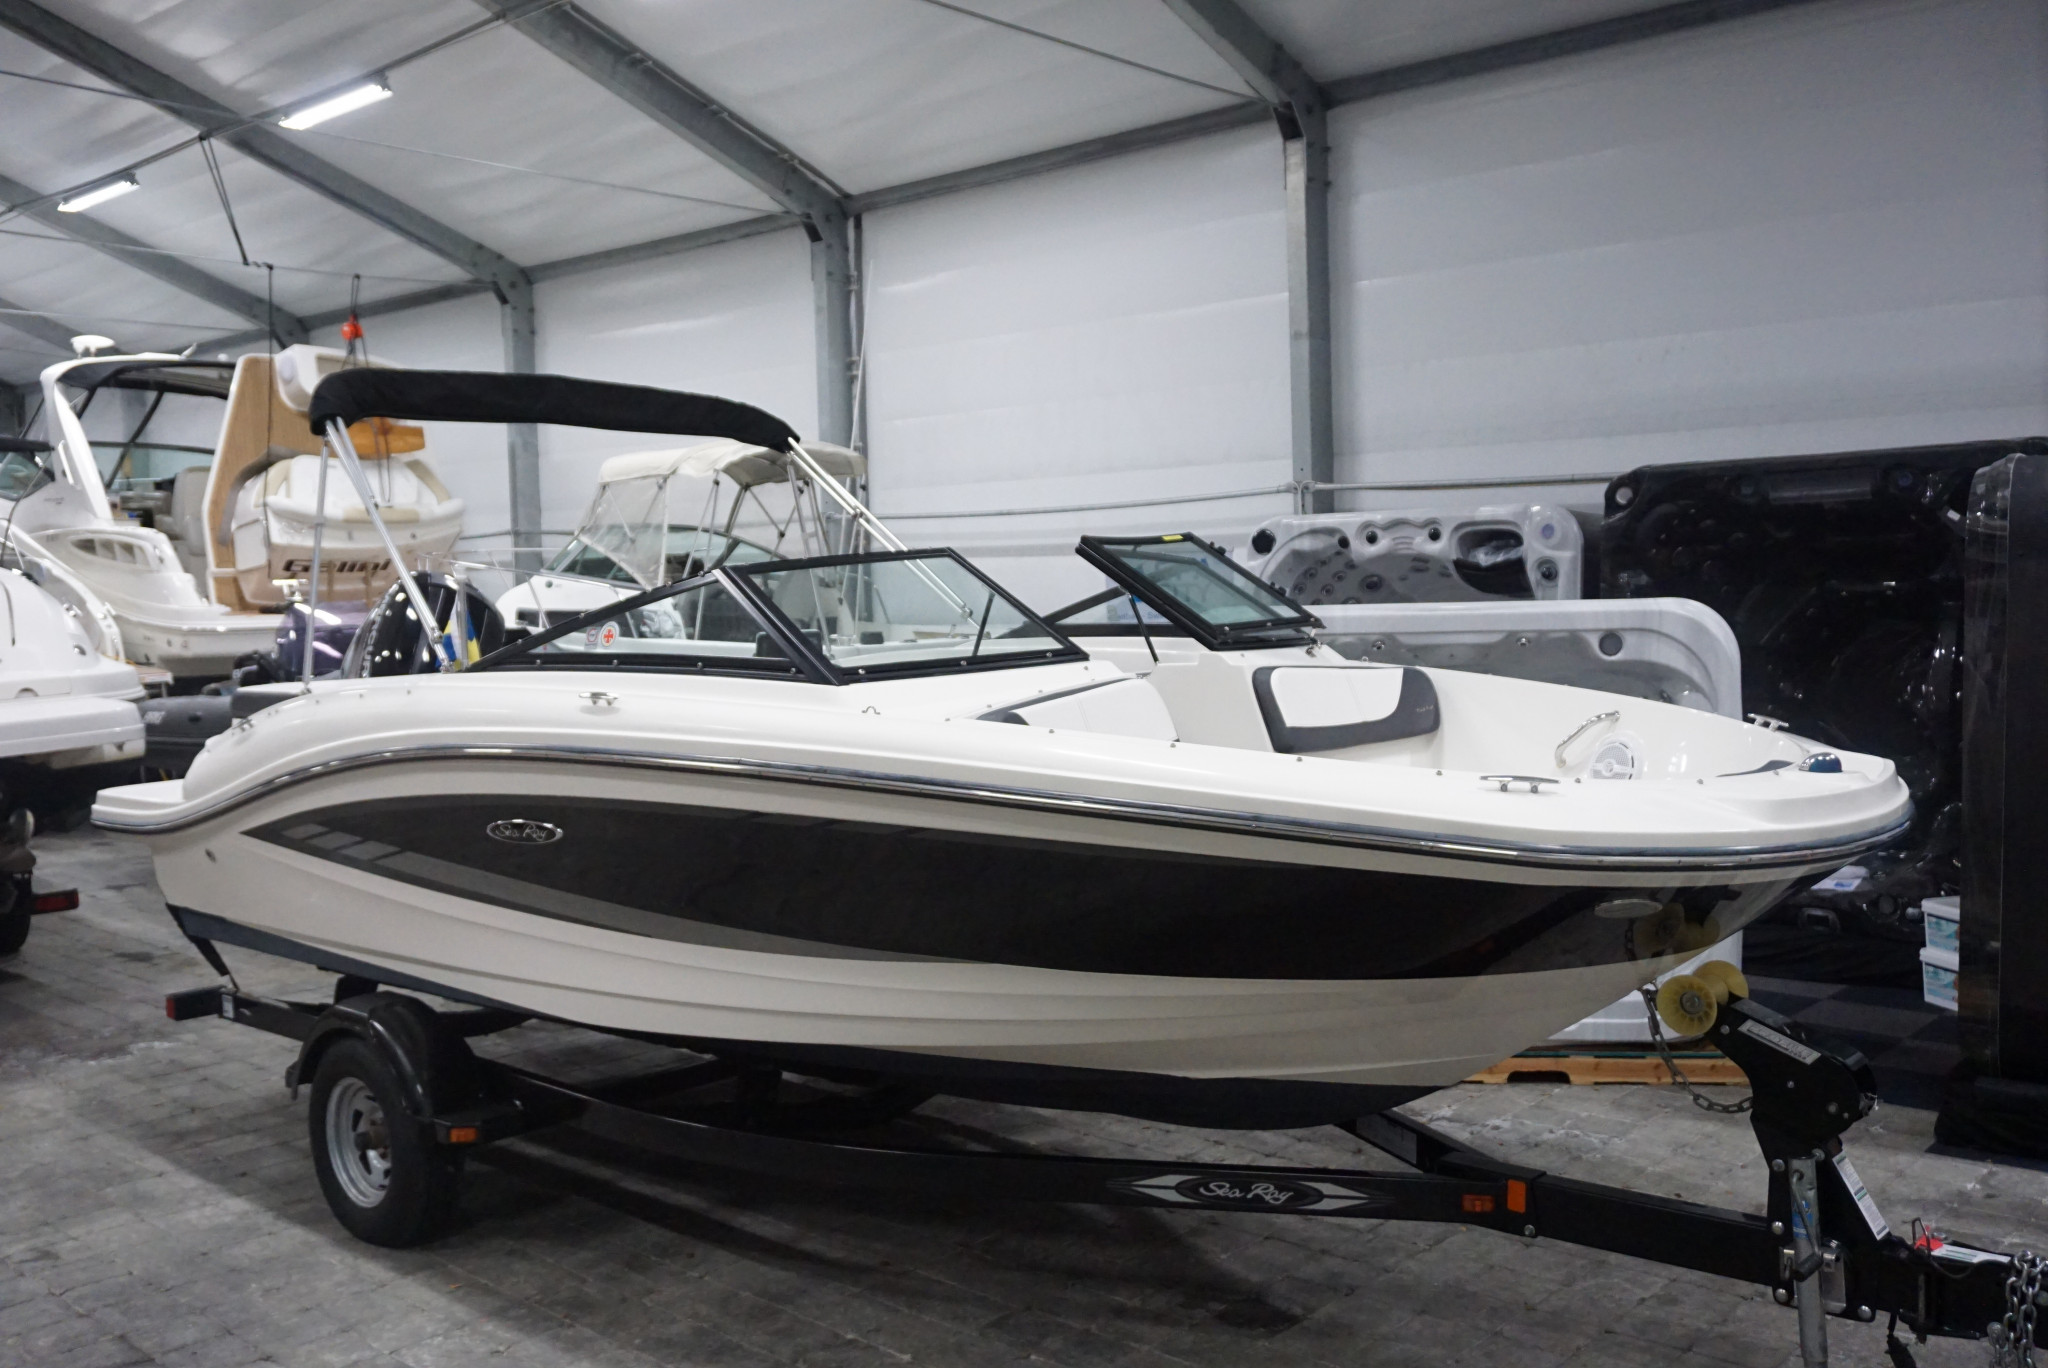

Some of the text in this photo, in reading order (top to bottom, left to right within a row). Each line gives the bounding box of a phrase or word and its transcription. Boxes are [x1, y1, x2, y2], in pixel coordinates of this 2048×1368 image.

[496, 823, 549, 841] Sea Ray
[1199, 1182, 1294, 1204] Sea Ray
